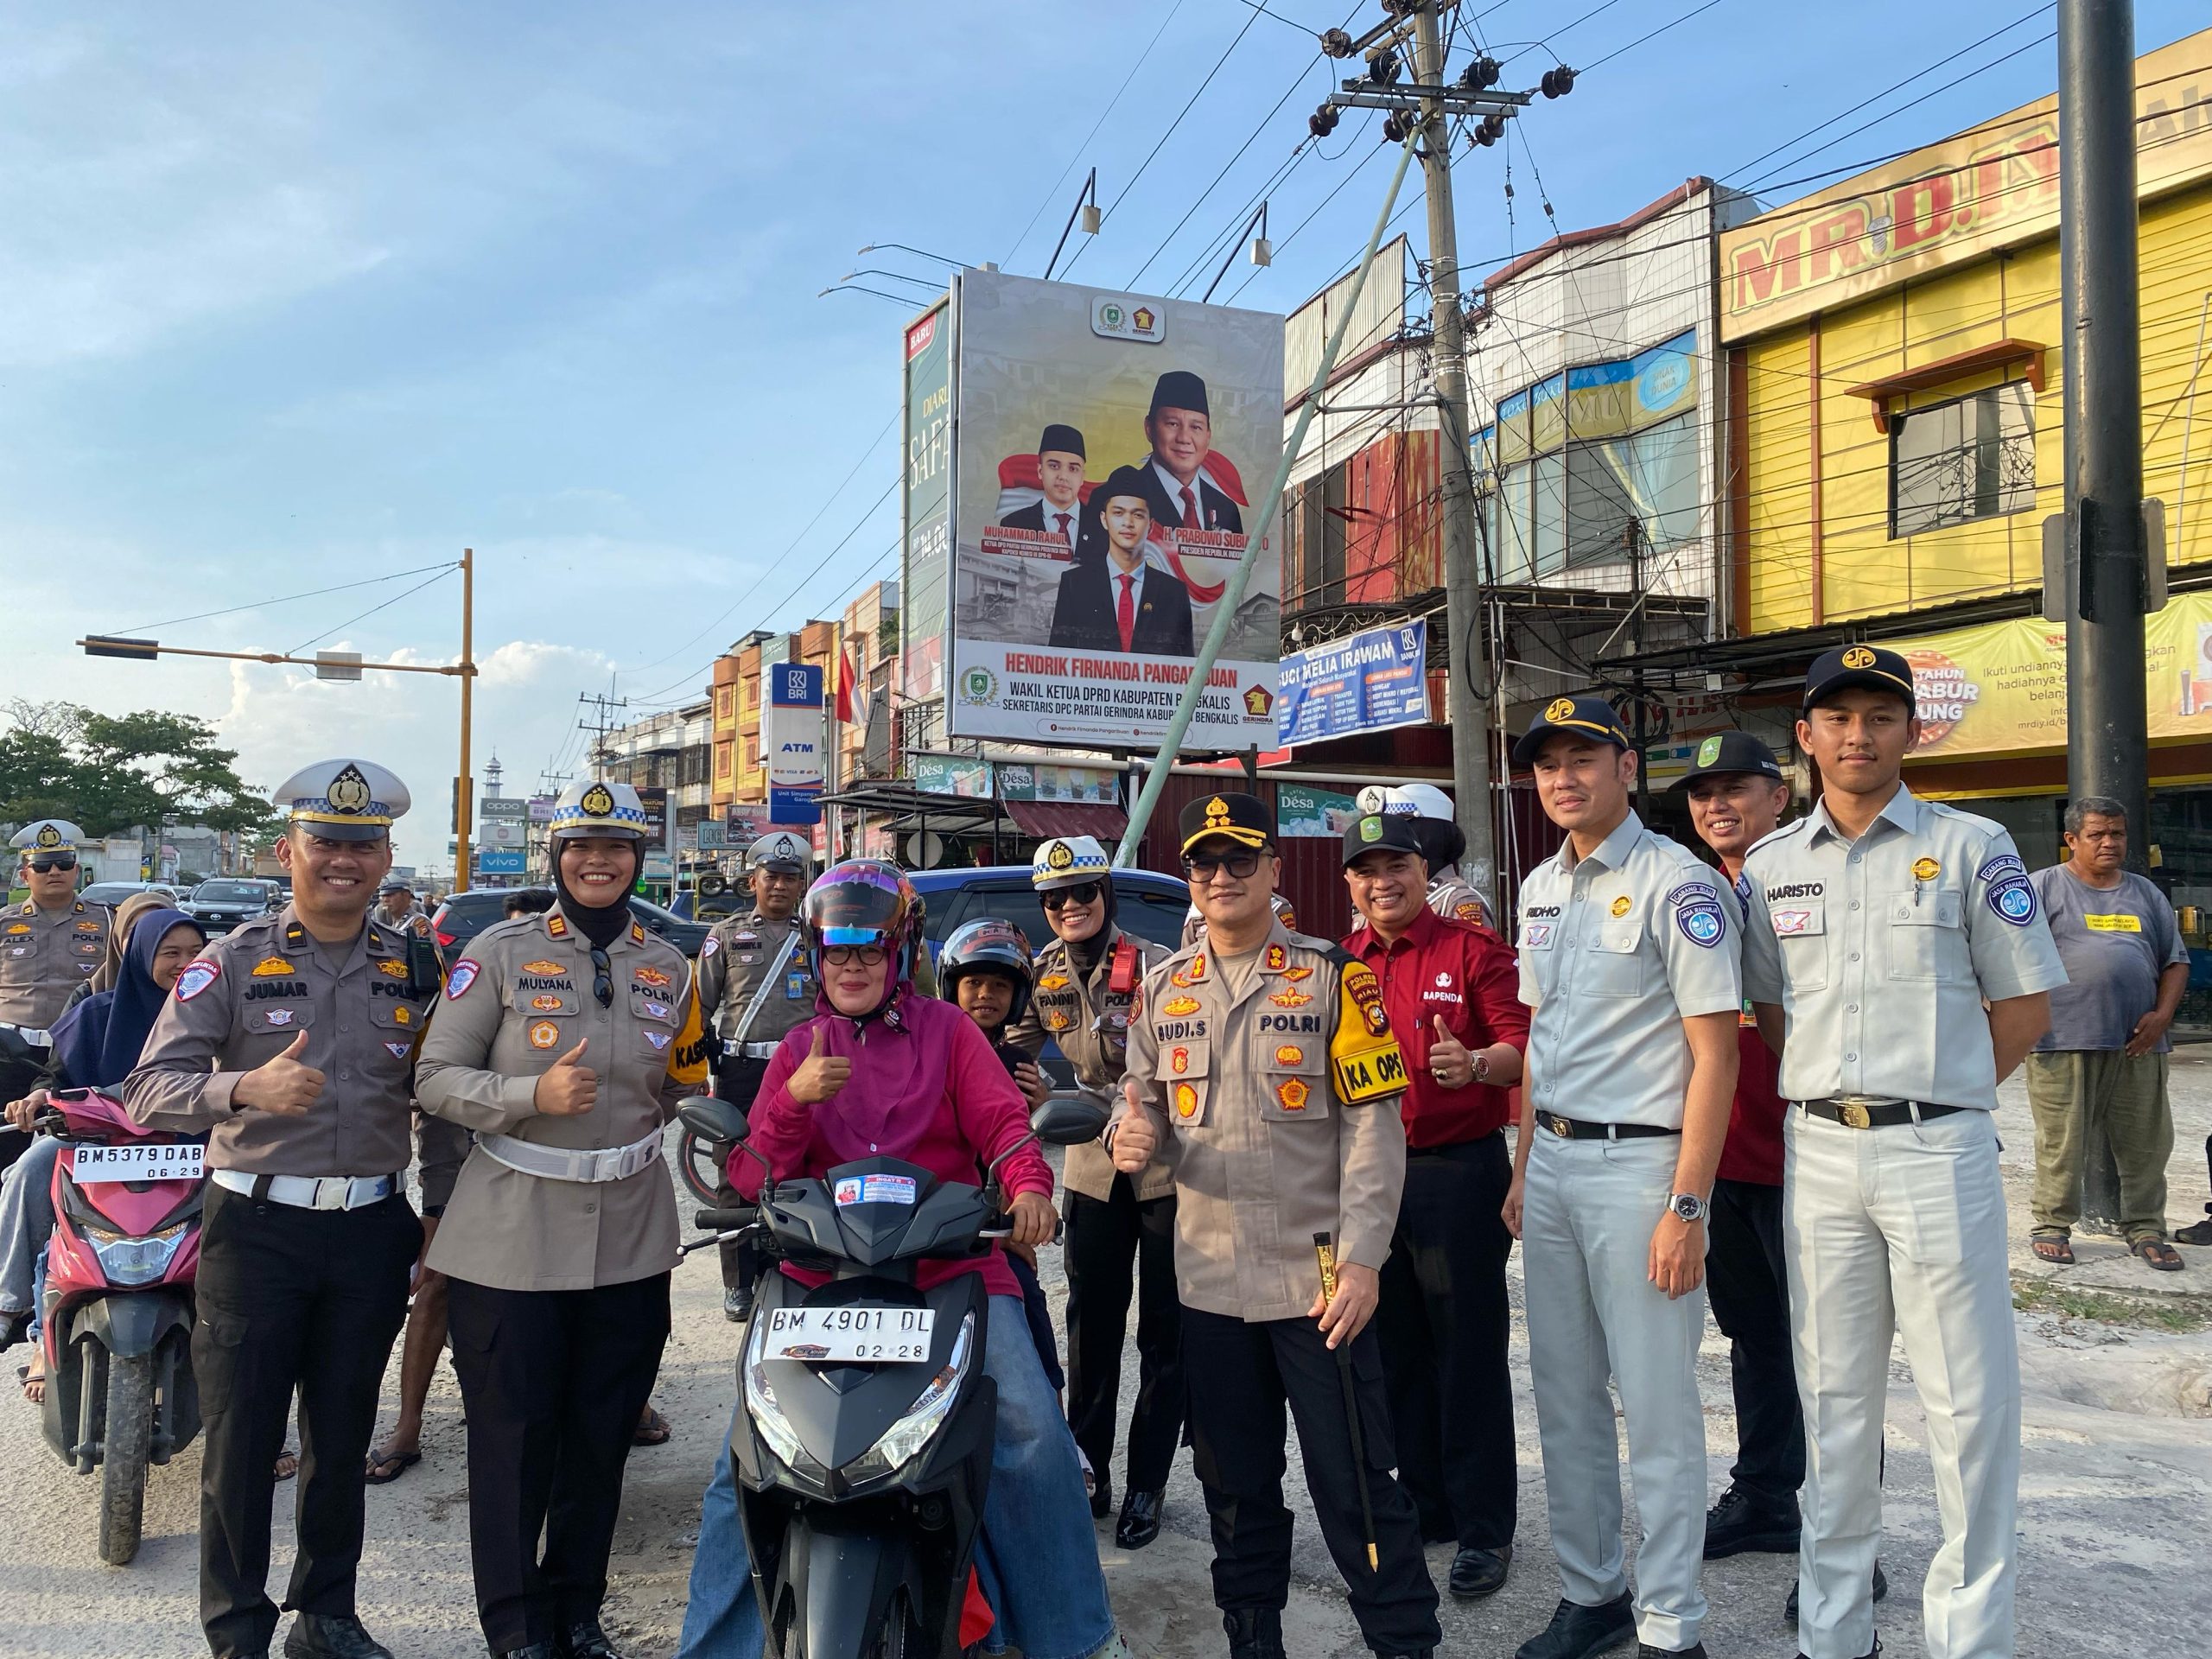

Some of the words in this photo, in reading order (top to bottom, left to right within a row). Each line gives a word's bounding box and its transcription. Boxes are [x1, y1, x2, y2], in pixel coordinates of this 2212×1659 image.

[910, 323, 932, 350] BARU
[984, 526, 1036, 540] MUHAMMAD
[1037, 531, 1067, 545] RAHUL
[1164, 526, 1173, 542] H.
[1176, 528, 1221, 546] PRABOWO
[1224, 532, 1268, 550] SUBIAO
[1180, 546, 1205, 556] PRESIDEN
[1205, 548, 1228, 558] REPUBLIK
[1229, 550, 1243, 559] INDON
[1341, 641, 1392, 670] IRAWAN
[2145, 645, 2176, 658] gkan
[1005, 652, 1068, 677] HENDRIK
[1071, 659, 1140, 682] FIRNANDA
[1143, 664, 1237, 689] PANGAUAN
[1917, 669, 1964, 681] TAHUN
[1983, 666, 2006, 678] Ikuti
[1997, 675, 2056, 690] hadiahnya
[788, 689, 807, 700] BRI
[1009, 682, 1044, 698] WAKIL
[1046, 684, 1080, 700] KETUA
[1083, 686, 1110, 702] DPRD
[1114, 689, 1173, 706] KABUPATEN
[1176, 693, 1230, 710] BGKALIS
[1002, 698, 1053, 715] SEKRETARIS
[1056, 702, 1072, 715] DPC
[1074, 703, 1102, 717] PARTAI
[1103, 705, 1145, 721] GERINDRA
[1147, 708, 1193, 722] KABUP
[1195, 711, 1238, 725] BENGKALIS
[1243, 715, 1274, 724] GERINDRA
[781, 743, 813, 753] ATM
[918, 763, 944, 778] Désa
[1002, 772, 1030, 785] Désa
[486, 803, 519, 811] oppo
[1281, 795, 1315, 809] Désa
[486, 857, 518, 867] vivo
[1984, 859, 2006, 877] CABANG
[1674, 886, 1698, 901] CABANG
[1699, 886, 1713, 895] RIAU
[1767, 881, 1823, 902] HARISTO
[1991, 886, 2005, 898] JASA
[2005, 880, 2027, 891] RAHARJA
[1526, 906, 1560, 918] RIDHO
[1681, 909, 1694, 919] JASA
[4, 935, 35, 944] ALEX
[73, 933, 104, 943] POLRI
[245, 982, 308, 1001] JUMAR
[371, 981, 419, 1002] POL
[518, 977, 574, 991] MULYANA
[631, 983, 675, 1005] POLRI
[1039, 994, 1074, 1007] FANNI
[1357, 988, 1379, 1000] RIAU
[1423, 991, 1463, 1004] BAPENDA
[1260, 1014, 1320, 1033] POLRI
[1344, 1061, 1373, 1091] KA
[1376, 1051, 1403, 1082] OPS
[107, 1147, 159, 1162] 5379
[164, 1147, 202, 1161] DAB
[772, 1310, 805, 1332] BM
[821, 1310, 882, 1331] 4901
[900, 1310, 930, 1332] DL
